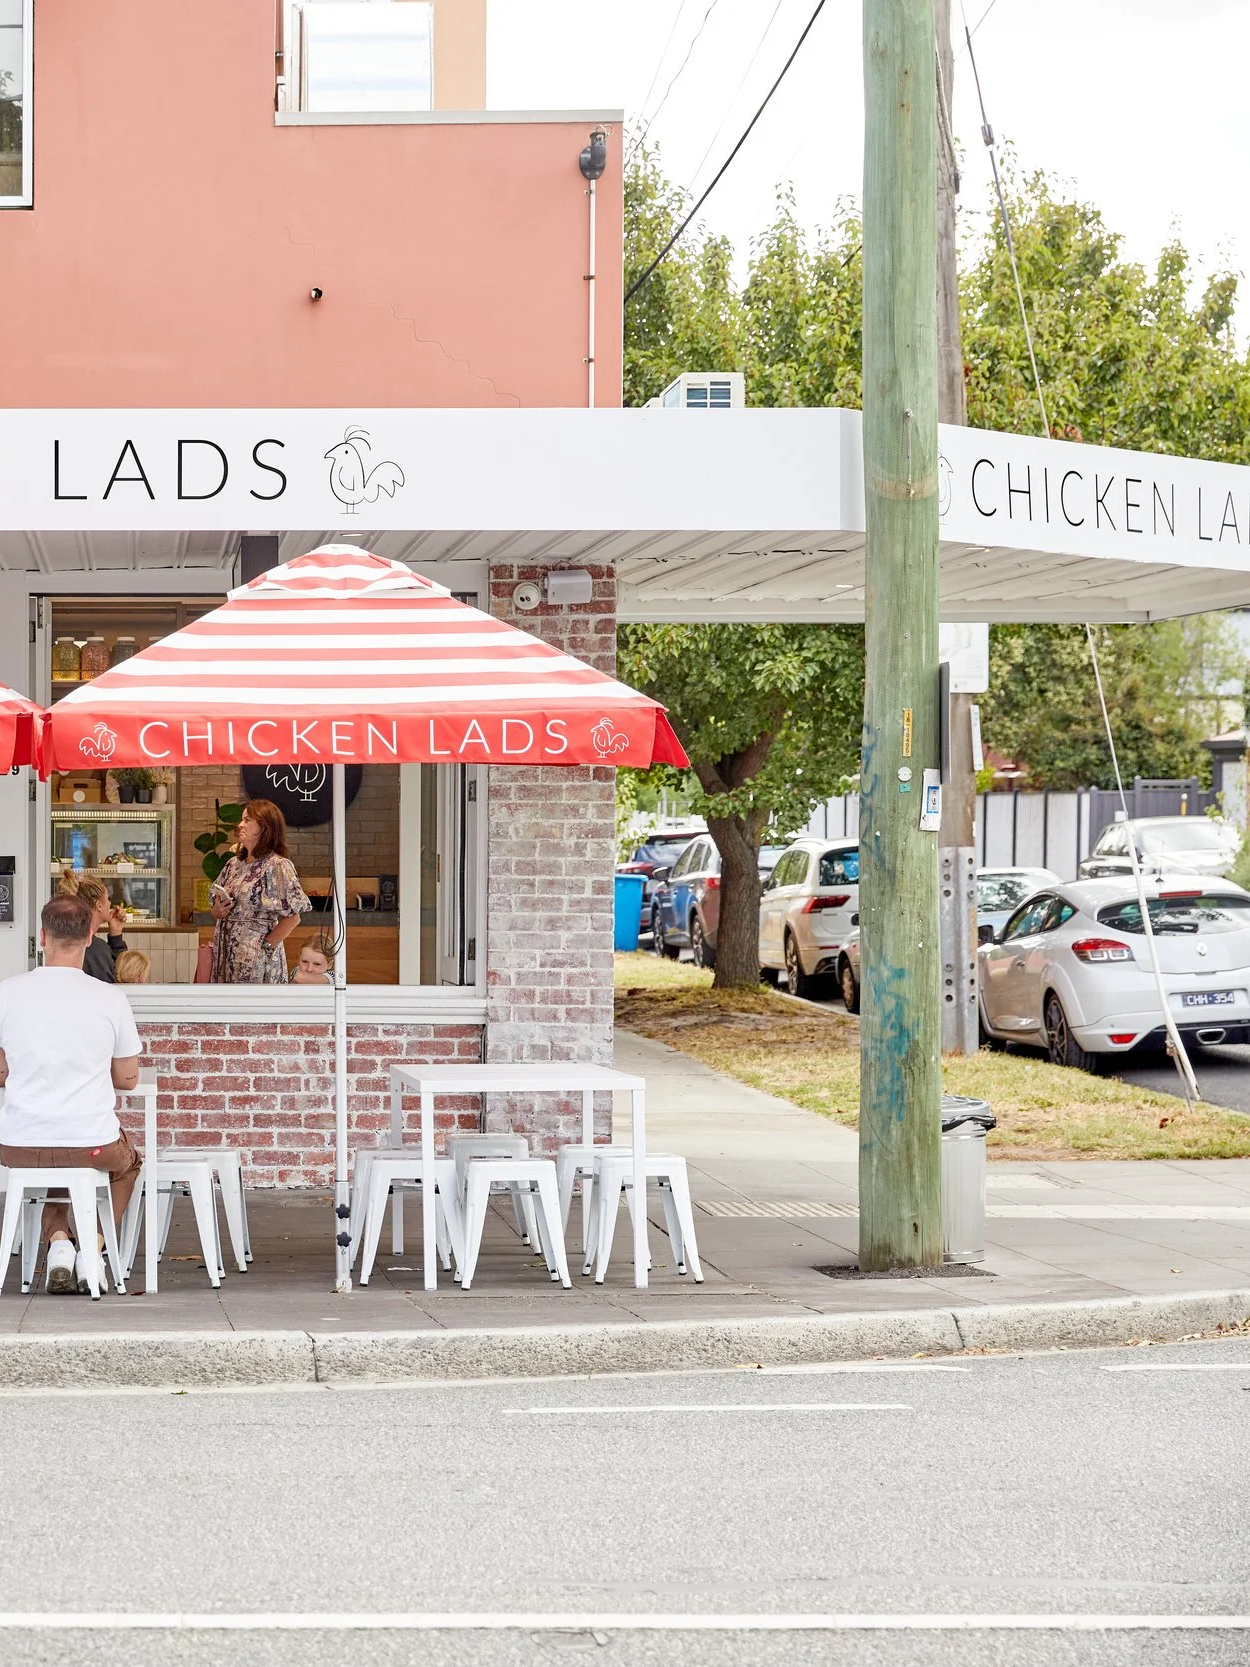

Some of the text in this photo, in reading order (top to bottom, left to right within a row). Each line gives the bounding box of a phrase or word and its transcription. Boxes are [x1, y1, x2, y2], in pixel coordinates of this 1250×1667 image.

[53, 438, 288, 501] LADS
[971, 458, 1250, 545] CHICKEN LA
[138, 718, 569, 759] CHICKEN LADS
